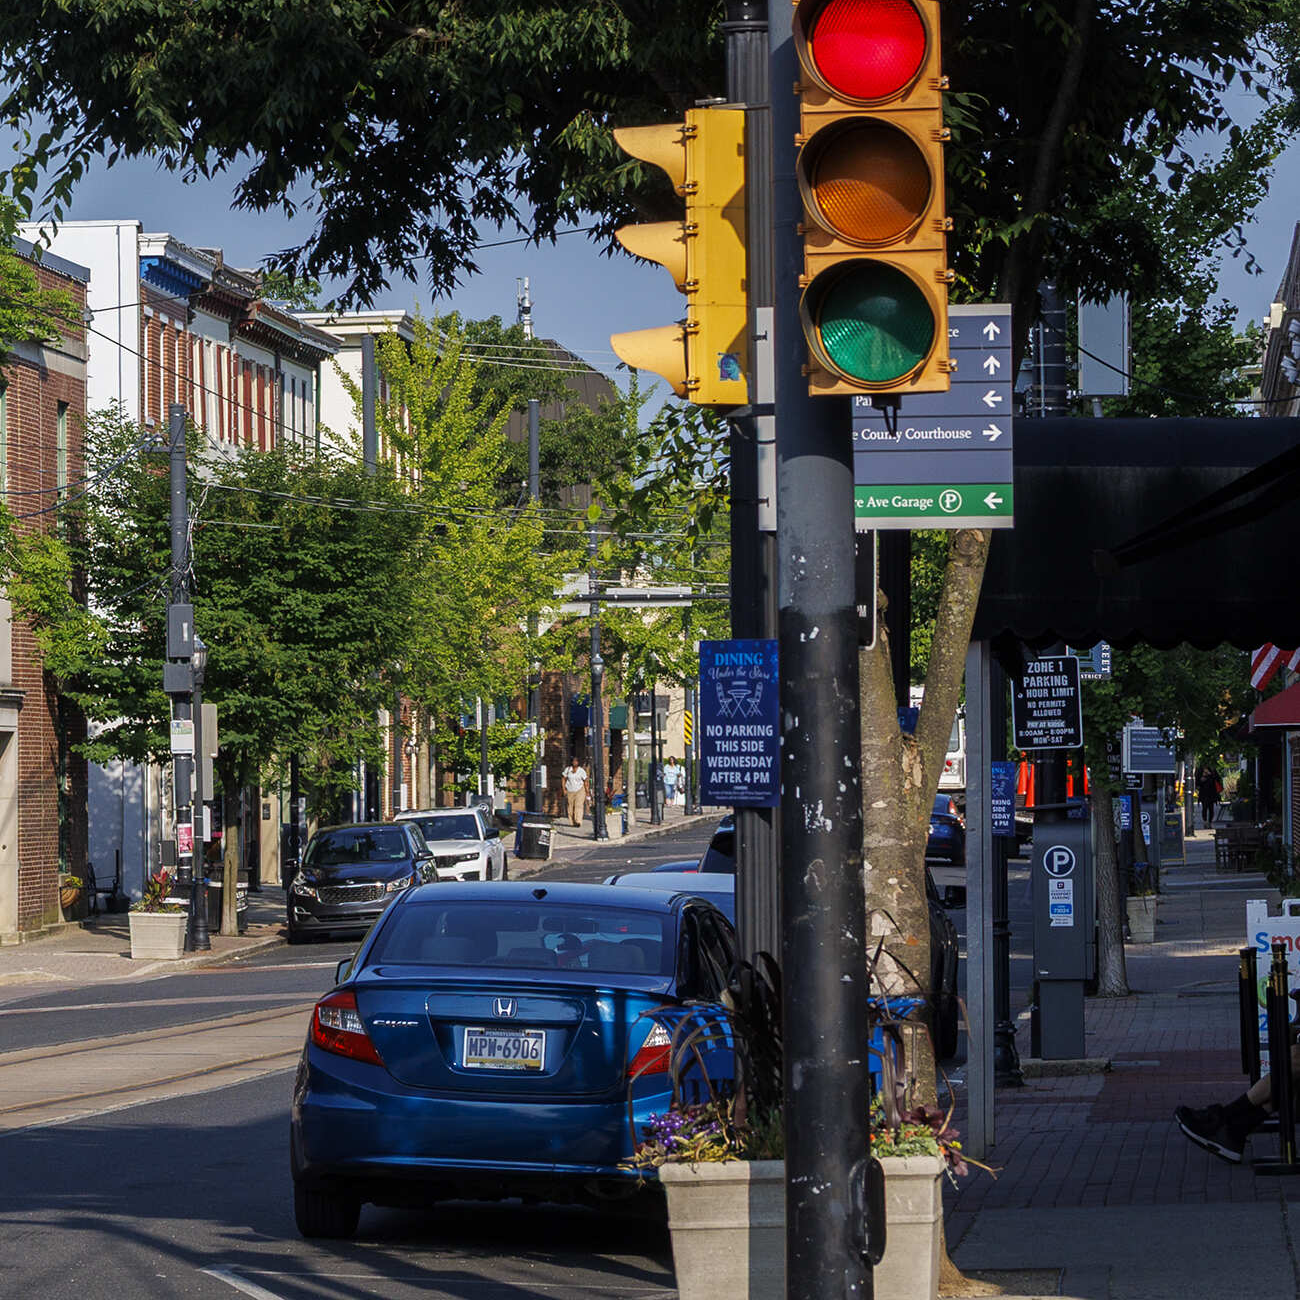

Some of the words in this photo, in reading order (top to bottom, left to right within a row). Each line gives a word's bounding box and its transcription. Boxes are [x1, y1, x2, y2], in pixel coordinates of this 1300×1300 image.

[861, 428, 902, 443] Couny
[905, 428, 972, 440] Courthouse
[867, 498, 889, 508] Ave
[892, 496, 933, 510] Garage
[715, 653, 763, 666] DINING
[1101, 644, 1110, 673] REET
[1027, 661, 1054, 673] ZONE
[1058, 661, 1063, 672] 1
[708, 667, 734, 680] Under
[1023, 675, 1068, 688] PARKING
[1026, 688, 1049, 698] HOUR
[1052, 687, 1075, 697] LIMIT
[1027, 701, 1036, 709] NO
[1038, 700, 1066, 708] PERMITS
[1033, 708, 1061, 717] ALLOWED
[706, 725, 723, 737] NO
[725, 724, 773, 737] PARKING
[715, 740, 738, 752] THIS
[740, 740, 764, 752] SIDE
[707, 756, 773, 768] WEDNESDAY
[710, 772, 742, 783] AFTER
[744, 772, 751, 783] 4
[753, 772, 770, 783] PM
